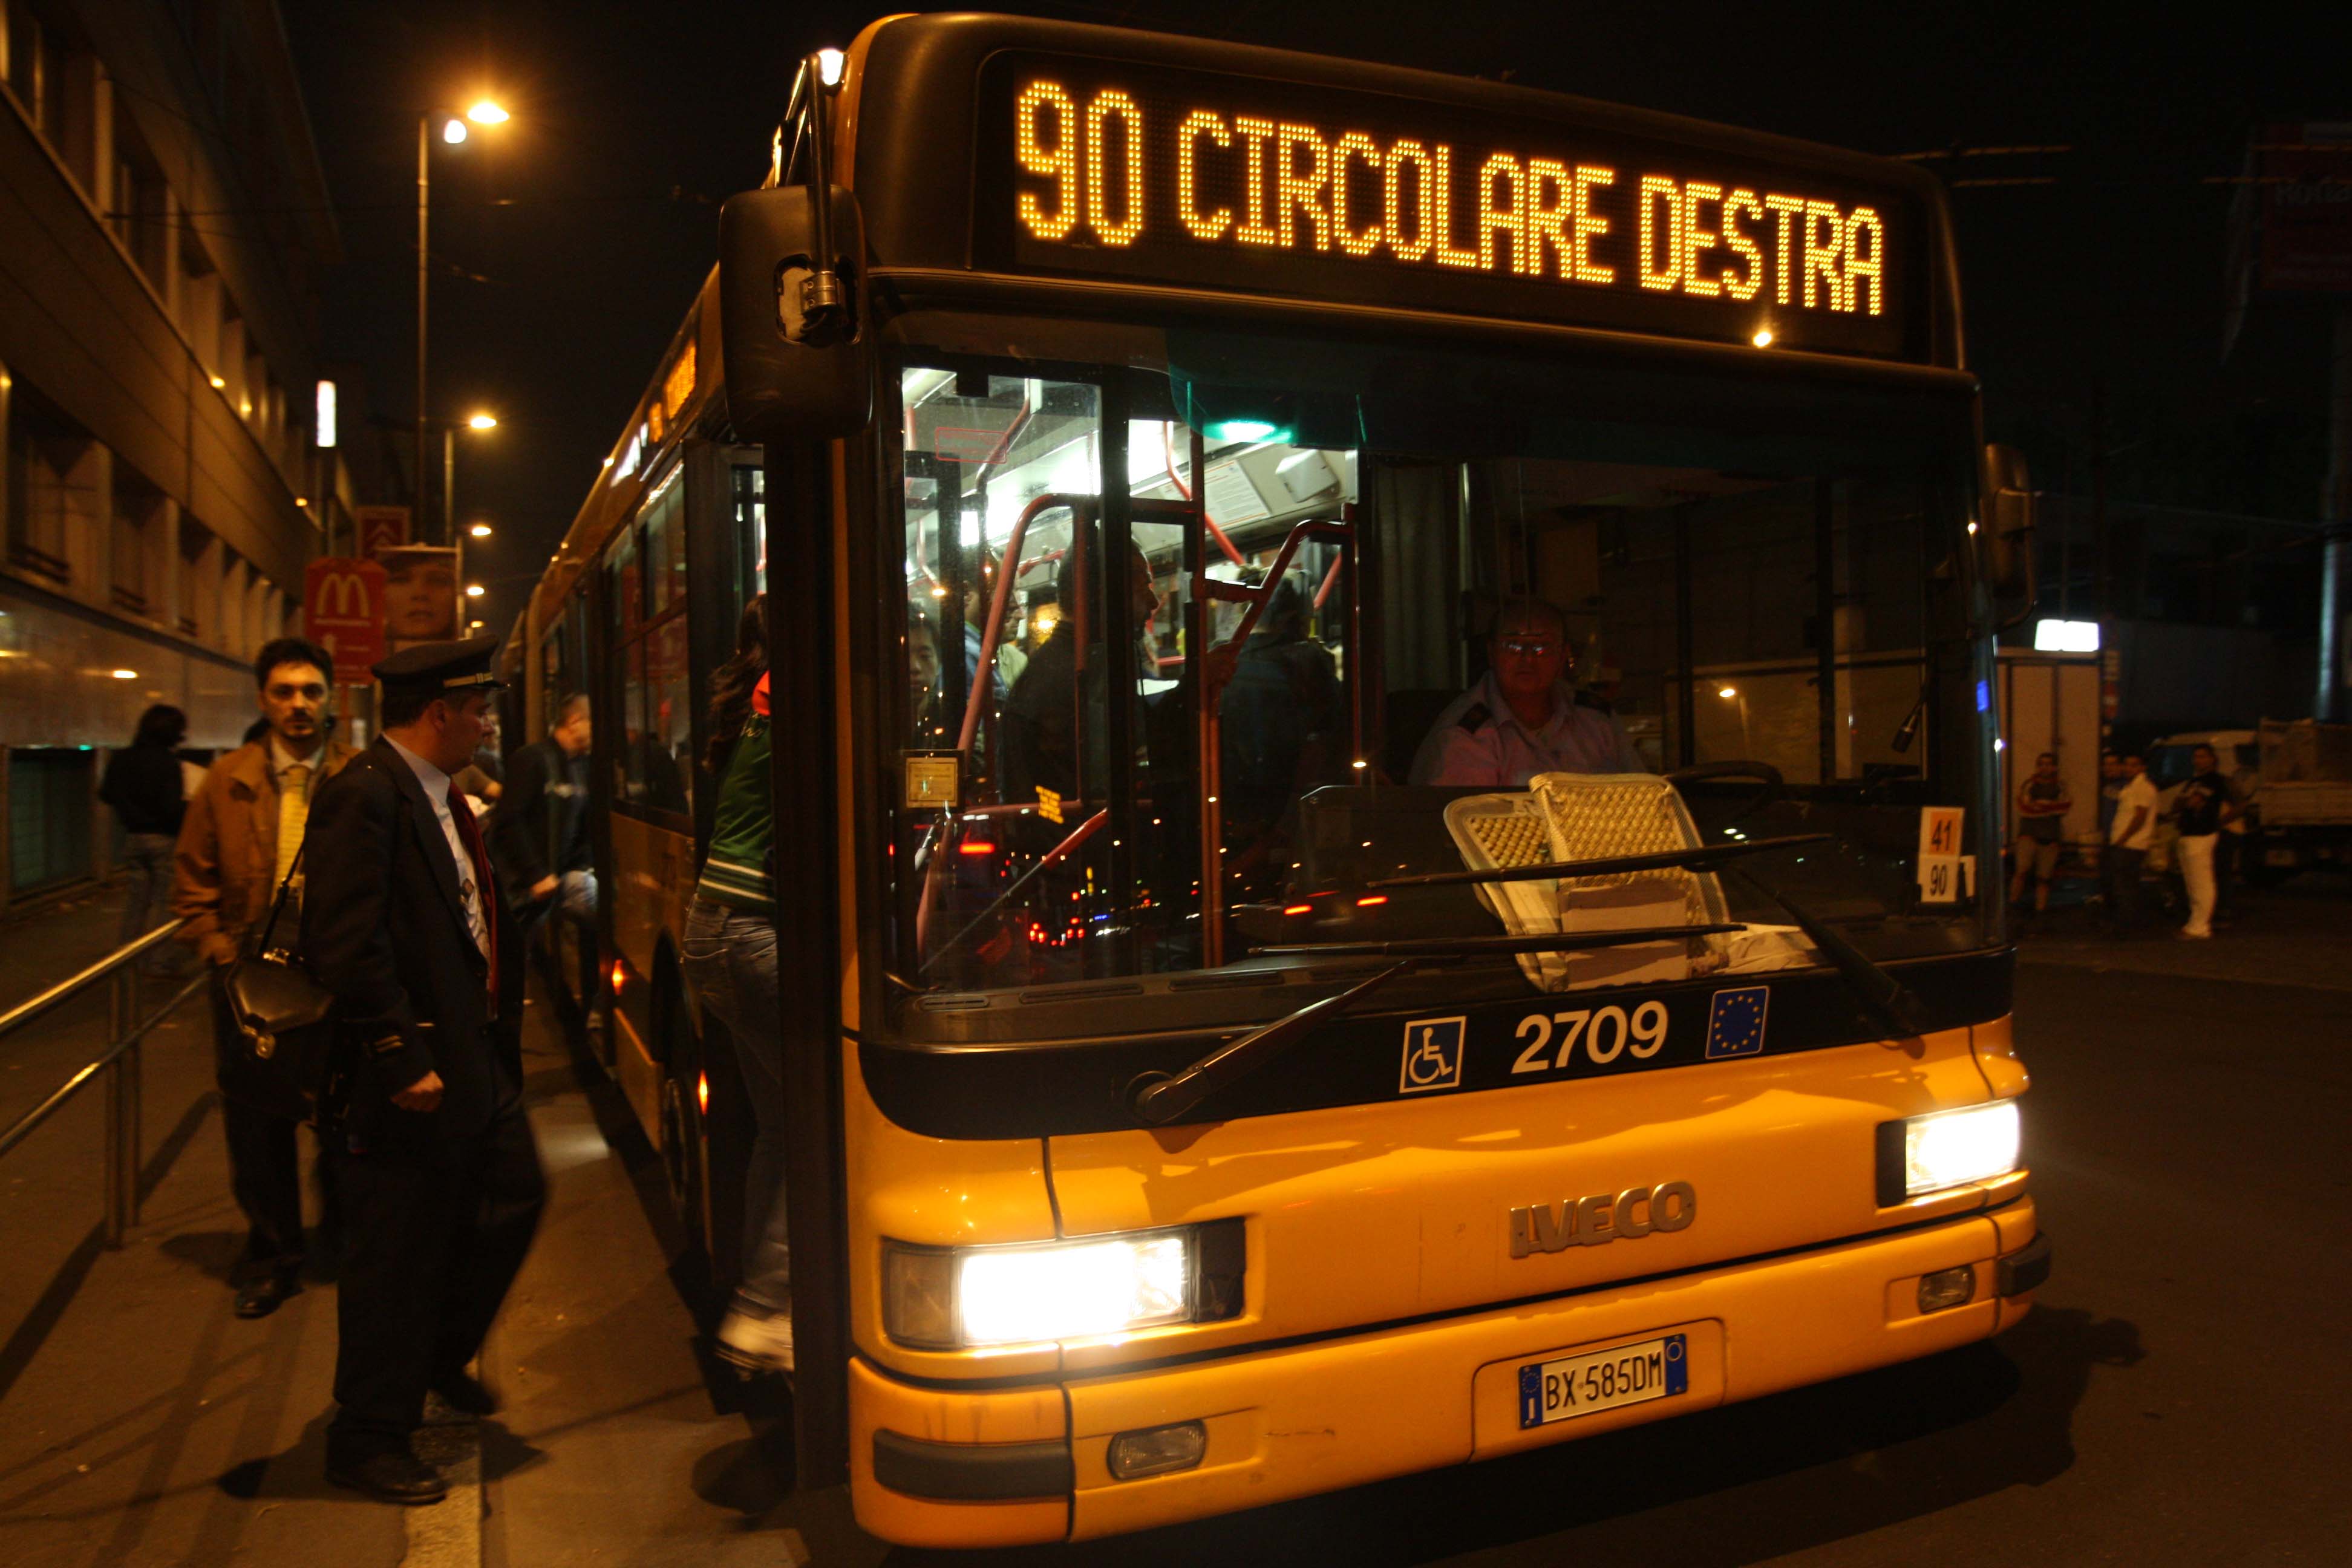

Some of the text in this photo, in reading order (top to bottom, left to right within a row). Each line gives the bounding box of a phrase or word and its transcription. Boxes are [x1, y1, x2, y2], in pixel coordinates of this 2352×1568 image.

[1018, 80, 1883, 316] 90 CIRCOLARE DESTRA
[1931, 820, 1952, 851] 41
[1930, 864, 1947, 897] 90
[1511, 1000, 1669, 1074] 2709
[1510, 1180, 1696, 1259] IVECO
